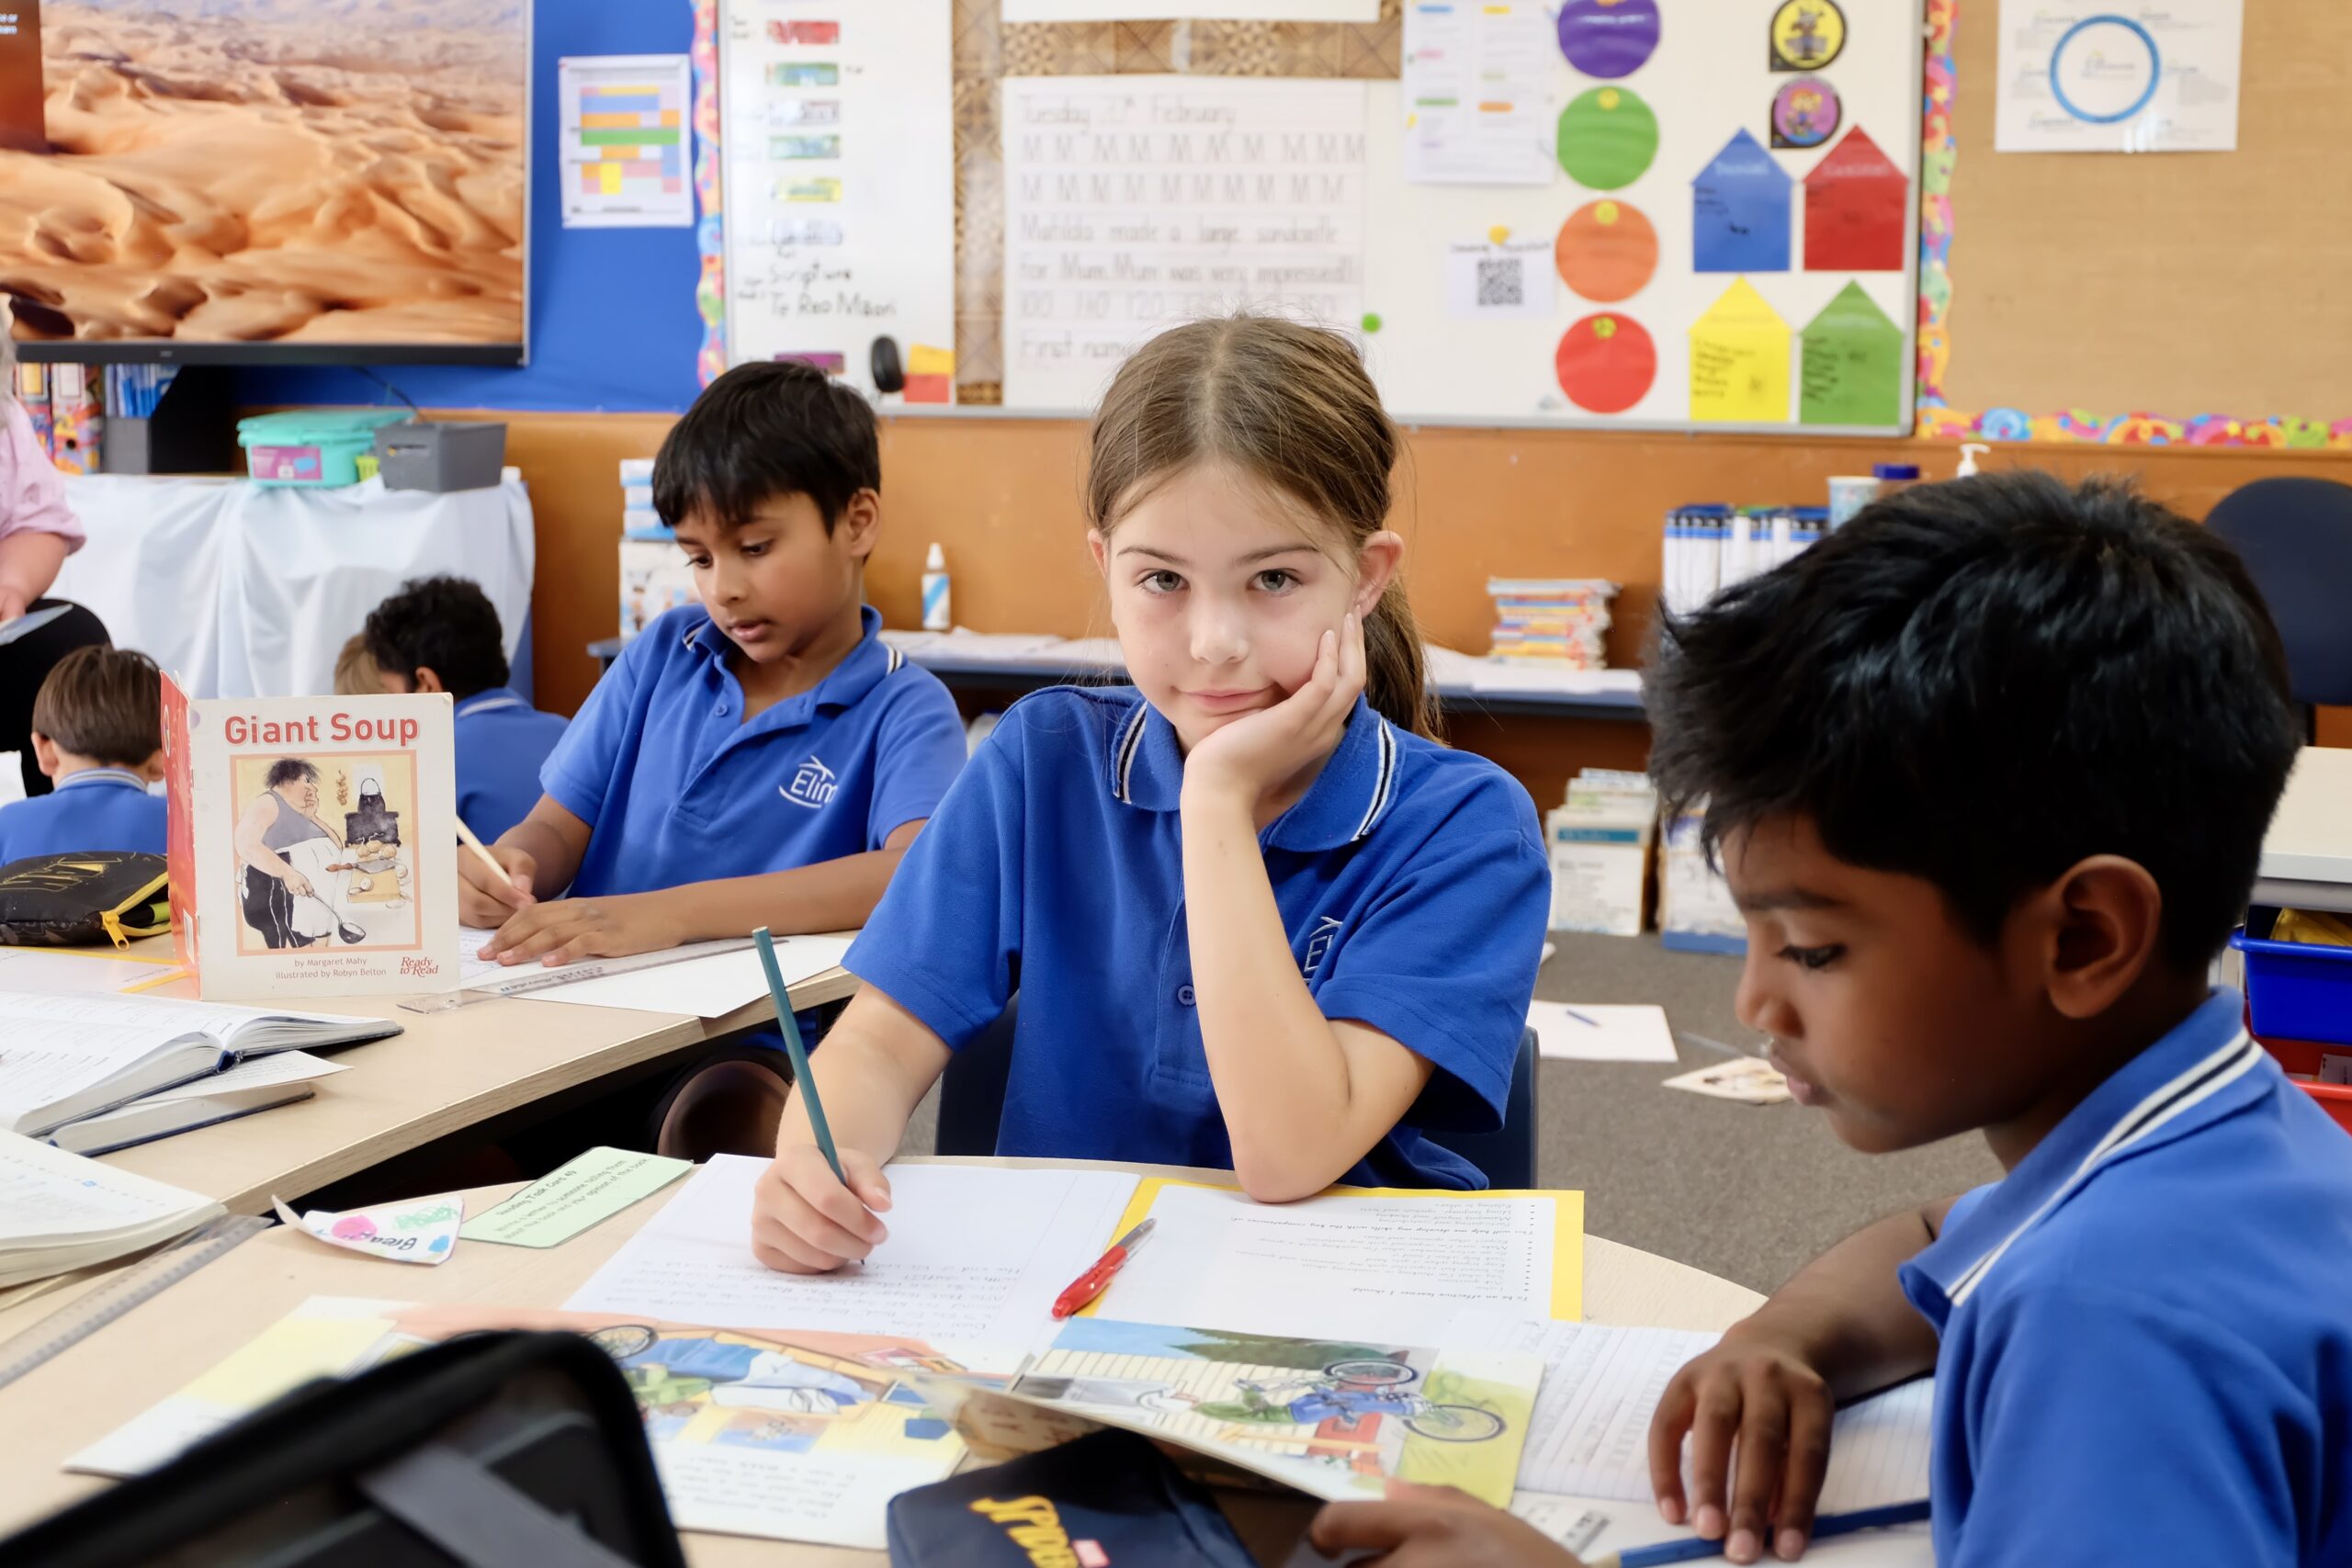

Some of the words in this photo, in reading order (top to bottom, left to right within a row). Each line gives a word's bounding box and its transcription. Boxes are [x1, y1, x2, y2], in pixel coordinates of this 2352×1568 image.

[1018, 95, 1091, 135] Tuesday
[1150, 95, 1236, 134] February
[1108, 217, 1158, 243] made
[1169, 227, 1181, 243] a
[224, 715, 320, 745] Giant
[330, 713, 419, 746] Soup
[790, 769, 838, 804] Elim
[294, 959, 304, 968] by
[307, 956, 344, 967] Margaret
[345, 956, 368, 967] Mahy
[400, 964, 410, 975] to
[412, 964, 439, 977] Read
[401, 956, 434, 968] Ready
[276, 970, 319, 979] illustrated
[321, 969, 332, 978] by
[333, 968, 359, 978] Robyn
[360, 967, 387, 976] Belton
